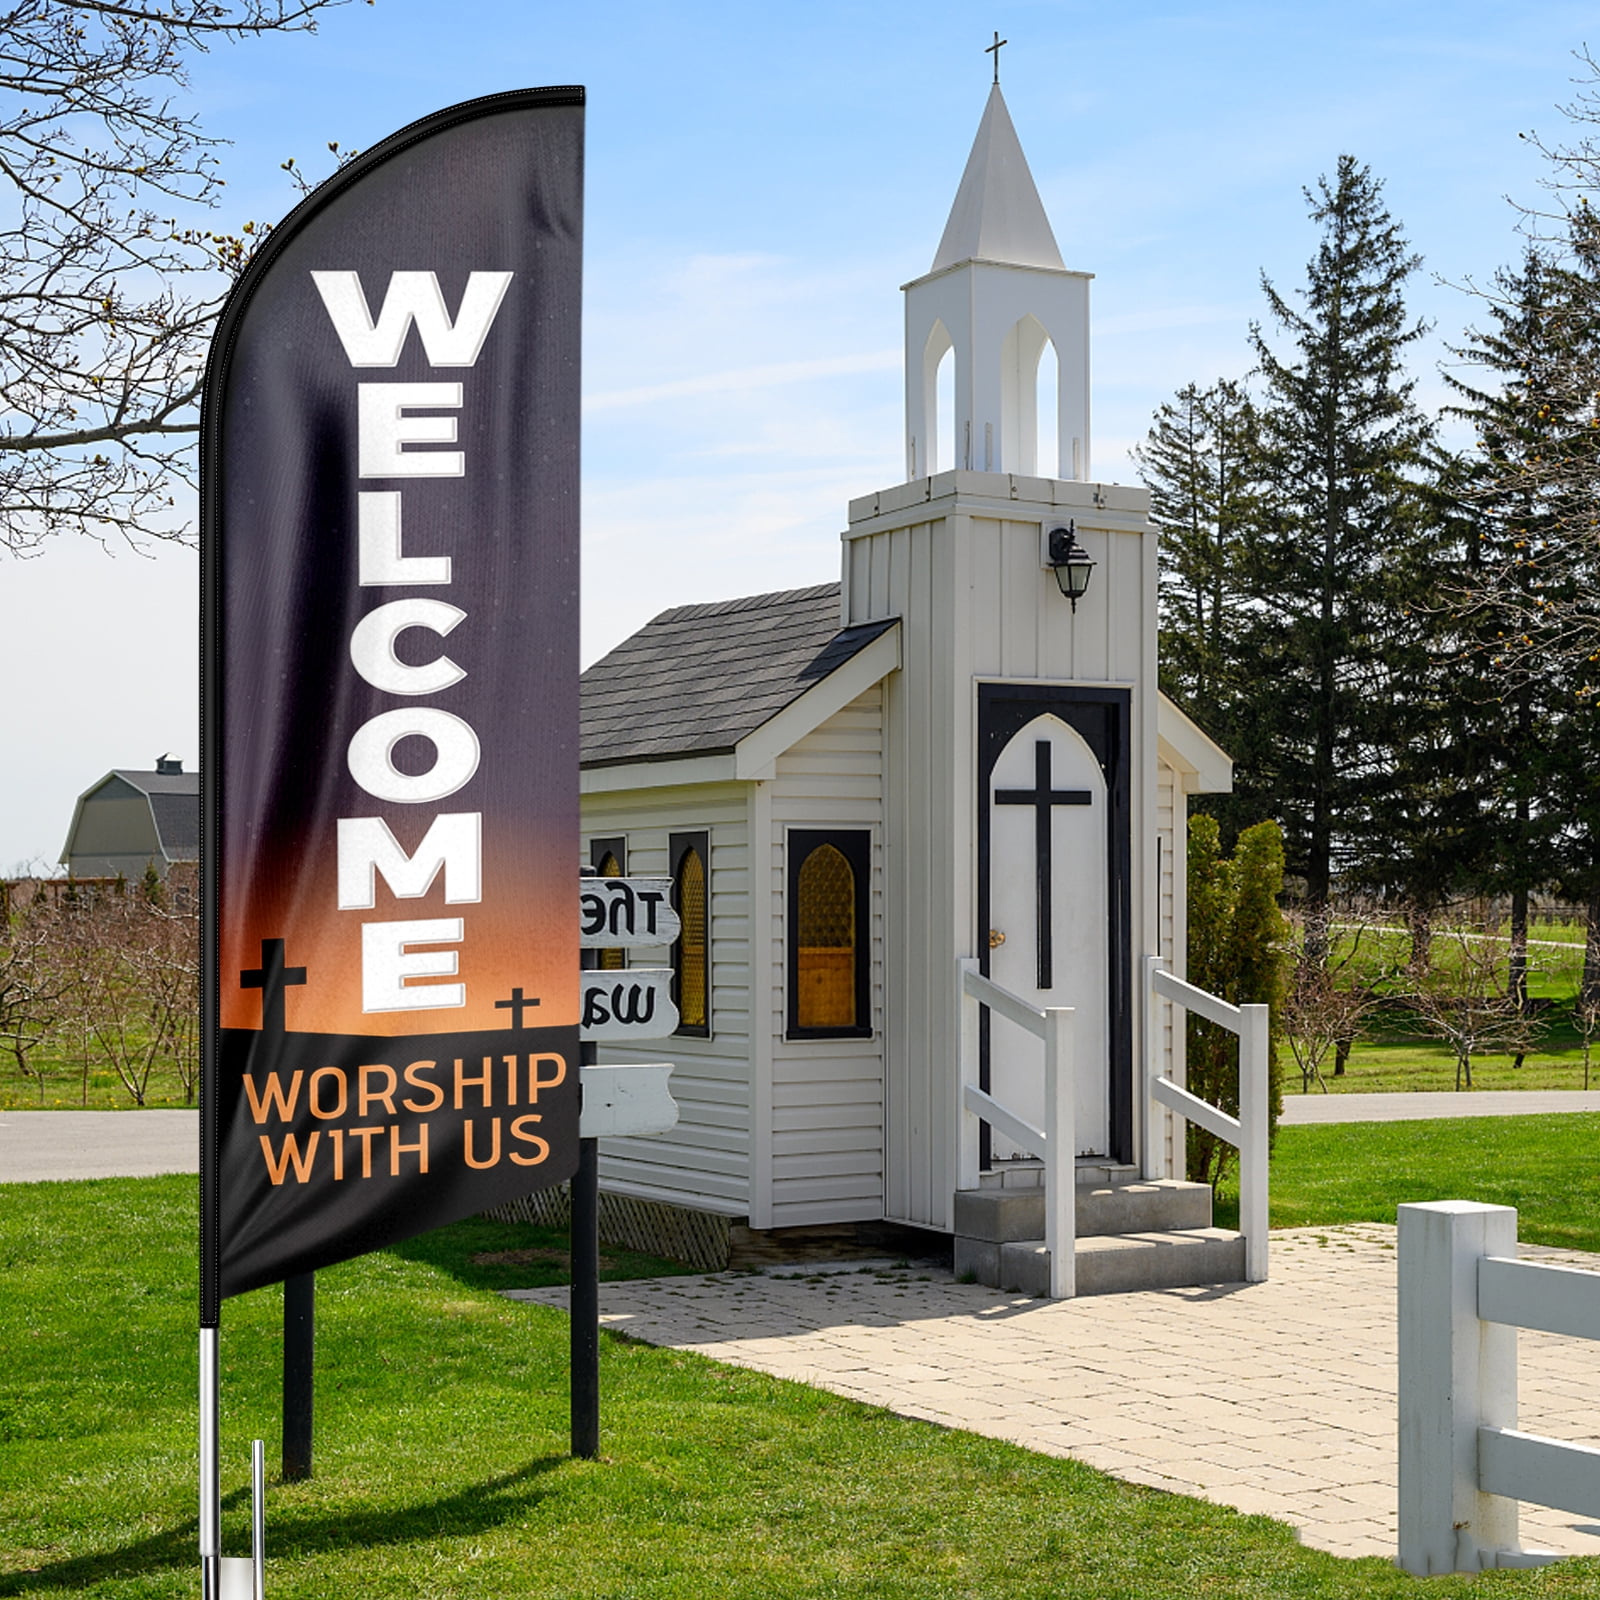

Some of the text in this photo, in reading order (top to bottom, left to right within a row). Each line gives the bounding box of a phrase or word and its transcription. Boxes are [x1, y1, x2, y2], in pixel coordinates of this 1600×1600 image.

[310, 270, 514, 1014] WELCOME
[242, 1052, 567, 1124] WORSHIP
[259, 1114, 550, 1186] WITH US
